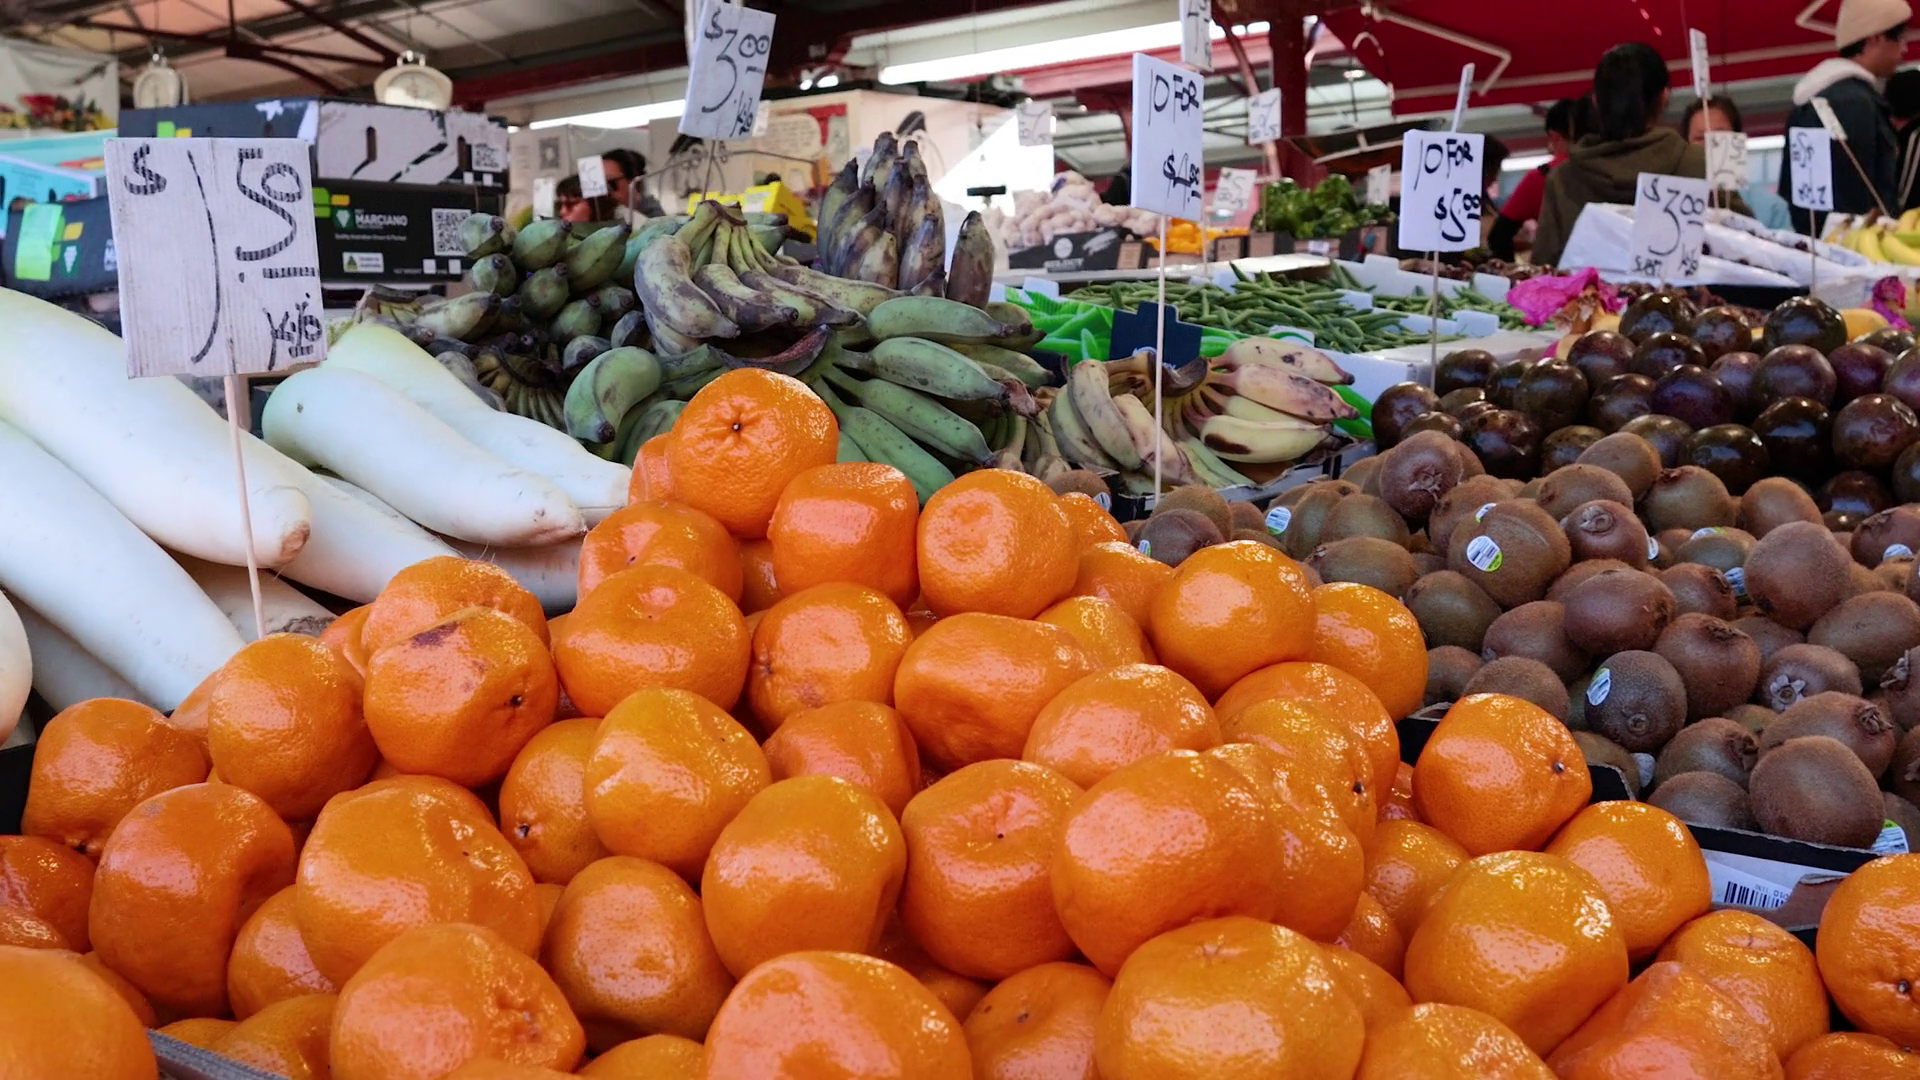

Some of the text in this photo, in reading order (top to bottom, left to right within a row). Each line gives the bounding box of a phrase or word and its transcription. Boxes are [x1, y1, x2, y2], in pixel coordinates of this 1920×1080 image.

[1147, 69, 1170, 126] 10
[1173, 74, 1200, 124] FOR
[1414, 138, 1443, 191] 10
[1445, 138, 1474, 179] FOR
[355, 213, 408, 227] MARCIANO
